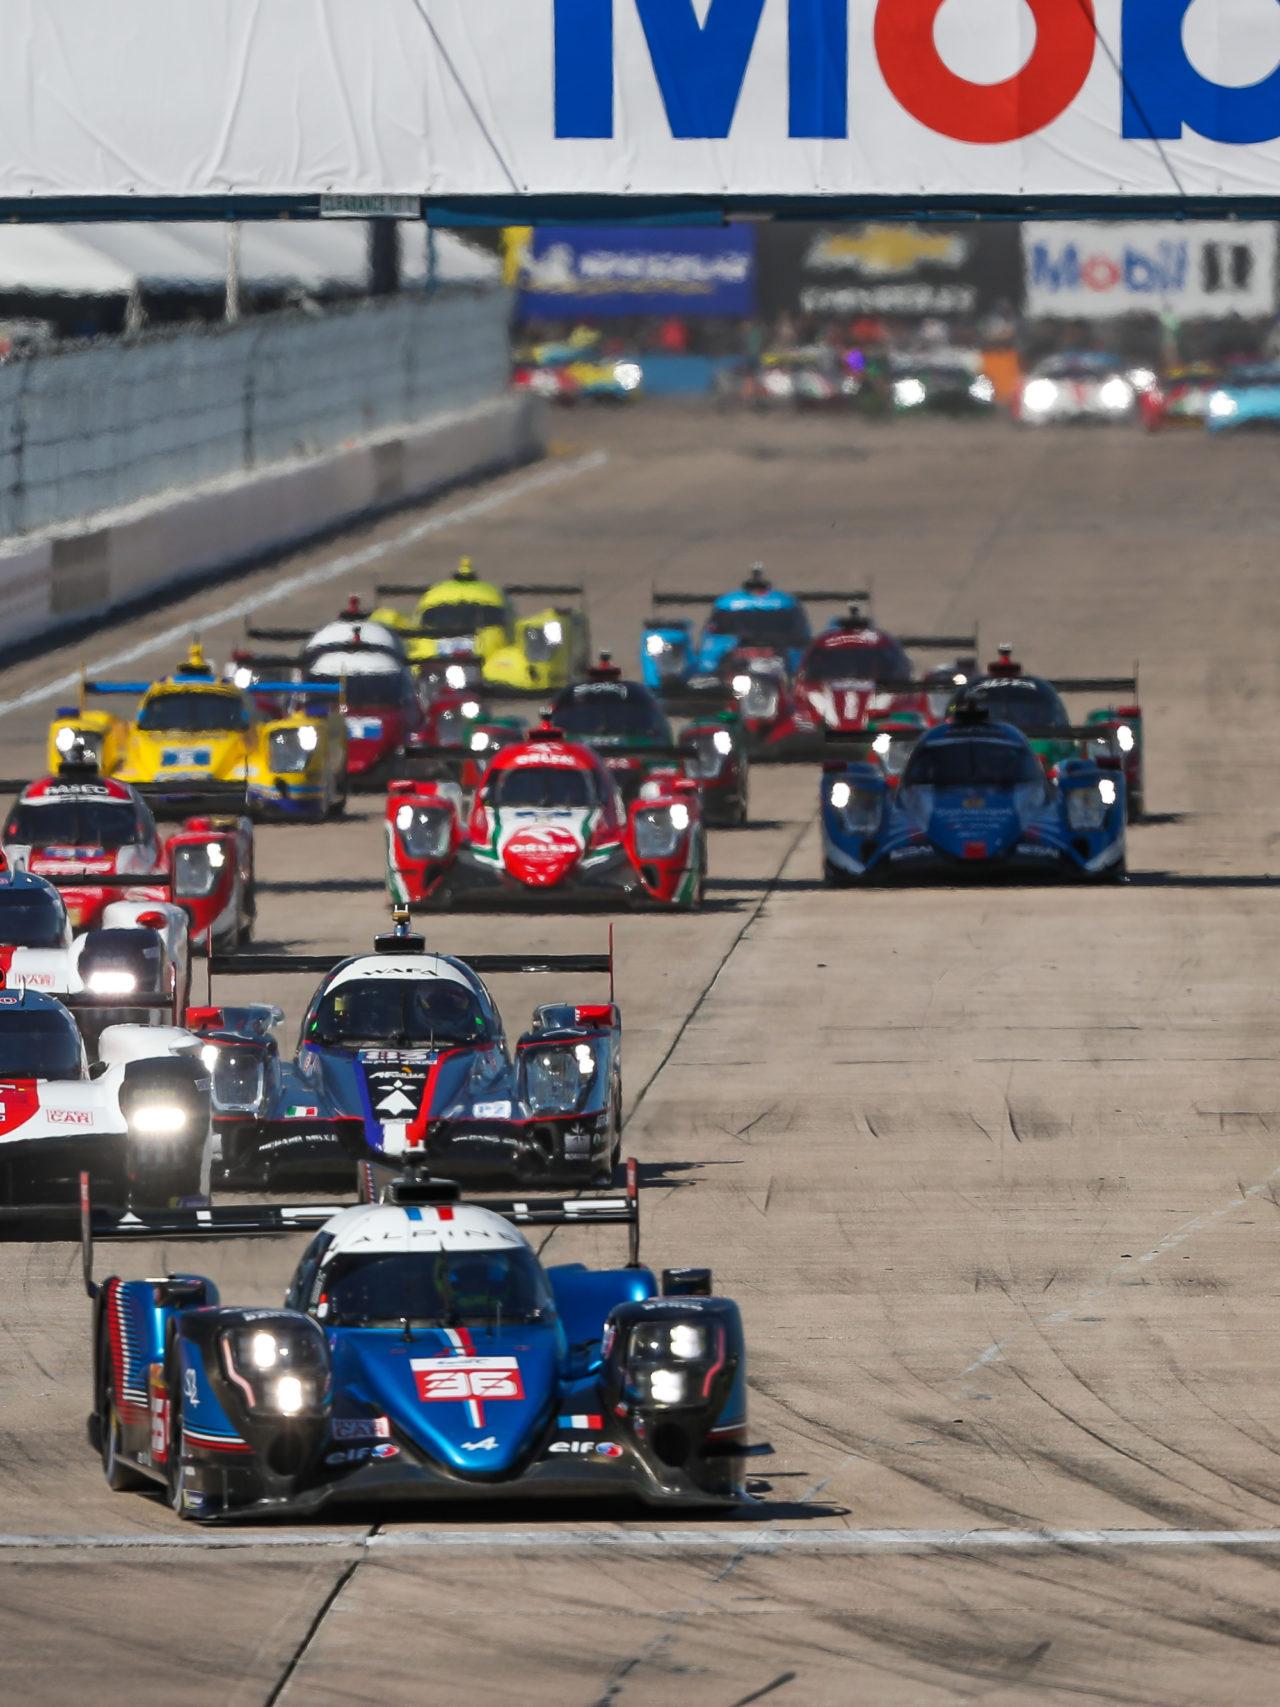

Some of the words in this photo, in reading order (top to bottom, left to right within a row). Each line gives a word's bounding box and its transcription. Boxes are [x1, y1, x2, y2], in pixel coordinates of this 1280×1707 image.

[1032, 240, 1188, 293] Mobil
[515, 752, 575, 765] ORLEN
[507, 843, 577, 853] ORLEN
[50, 1114, 90, 1124] CAR
[352, 1229, 518, 1246] ALPINE
[423, 1371, 518, 1398] 36
[548, 1440, 595, 1454] elf
